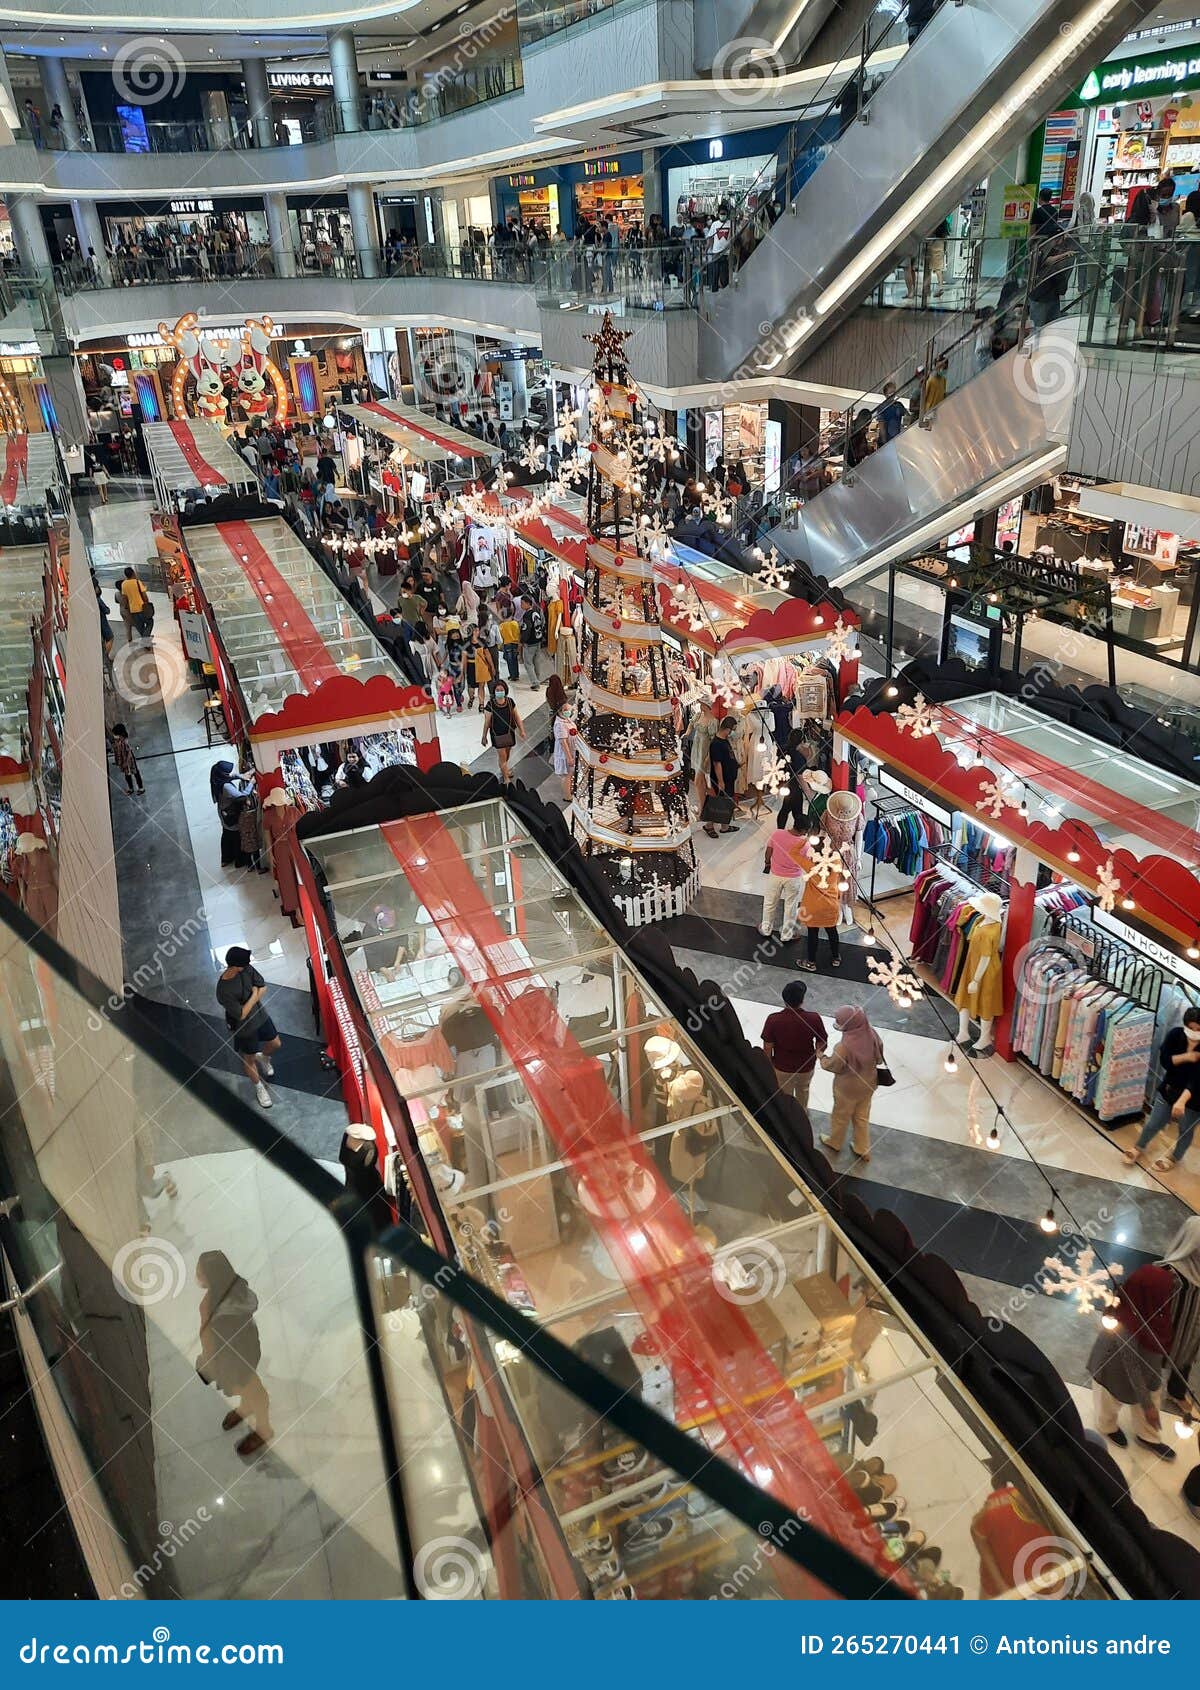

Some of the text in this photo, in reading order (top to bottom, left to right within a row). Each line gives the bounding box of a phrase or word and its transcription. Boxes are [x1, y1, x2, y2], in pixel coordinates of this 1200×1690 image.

[271, 73, 334, 87] LIVING GA
[1102, 68, 1133, 91] early
[1134, 60, 1188, 82] learning
[170, 199, 215, 213] SIXTY ONE
[903, 787, 925, 808] ELISA
[1124, 927, 1177, 969] IN HOME
